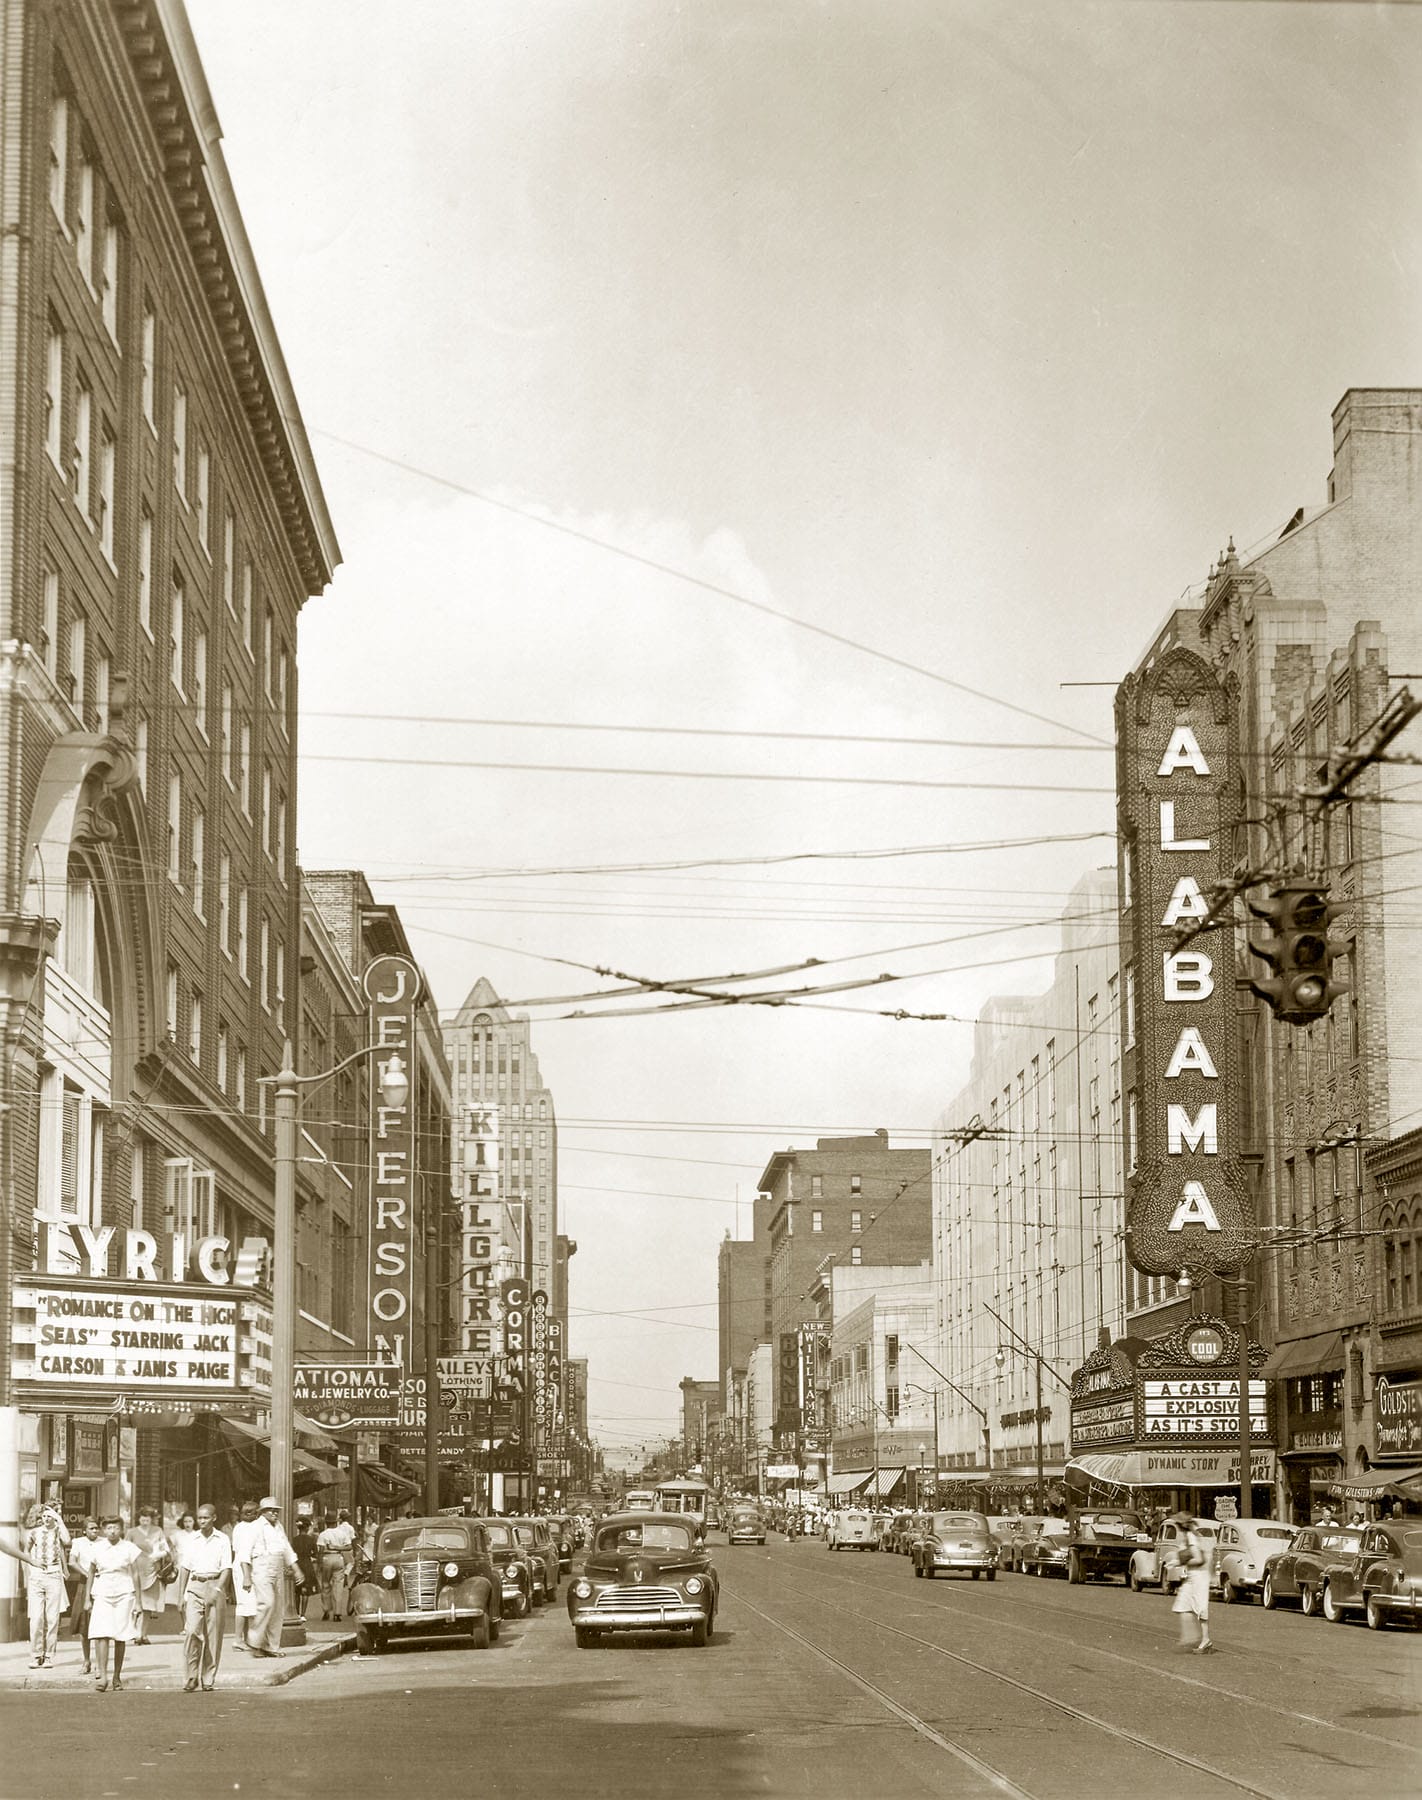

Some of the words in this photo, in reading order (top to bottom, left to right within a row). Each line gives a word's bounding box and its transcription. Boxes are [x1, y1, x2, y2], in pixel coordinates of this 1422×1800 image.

[1157, 725, 1221, 1231] ALABAMA
[40, 1222, 231, 1284] LYRIC
[130, 1301, 154, 1322] ON
[161, 1303, 193, 1324] THE
[201, 1304, 236, 1326] HIGH
[803, 1323, 825, 1331] NEW
[111, 1330, 183, 1350] STARRING
[194, 1335, 229, 1352] JACK
[1191, 1343, 1219, 1354] COOL
[436, 1361, 494, 1374] AILEYS
[549, 1325, 560, 1397] BLAC
[41, 1356, 104, 1376] CARSON
[116, 1360, 126, 1376] &
[133, 1359, 177, 1377] JANIS
[188, 1362, 230, 1380] PAIGE
[294, 1370, 390, 1386] ATIONAL
[441, 1377, 483, 1385] LOTHING
[311, 1391, 318, 1399] &
[319, 1388, 371, 1399] JEWELRY
[374, 1388, 390, 1399] CO.
[1161, 1383, 1171, 1395] A
[1179, 1382, 1220, 1395] CAST
[1229, 1382, 1240, 1395] A
[1166, 1401, 1240, 1414] EXPLOSIV
[1151, 1419, 1171, 1432] AS
[1178, 1419, 1203, 1432] IT'S
[1148, 1457, 1186, 1470] DYNAMIC
[1191, 1457, 1220, 1470] STORY
[1231, 1455, 1270, 1467] HUHREY
[1228, 1466, 1271, 1483] BOART
